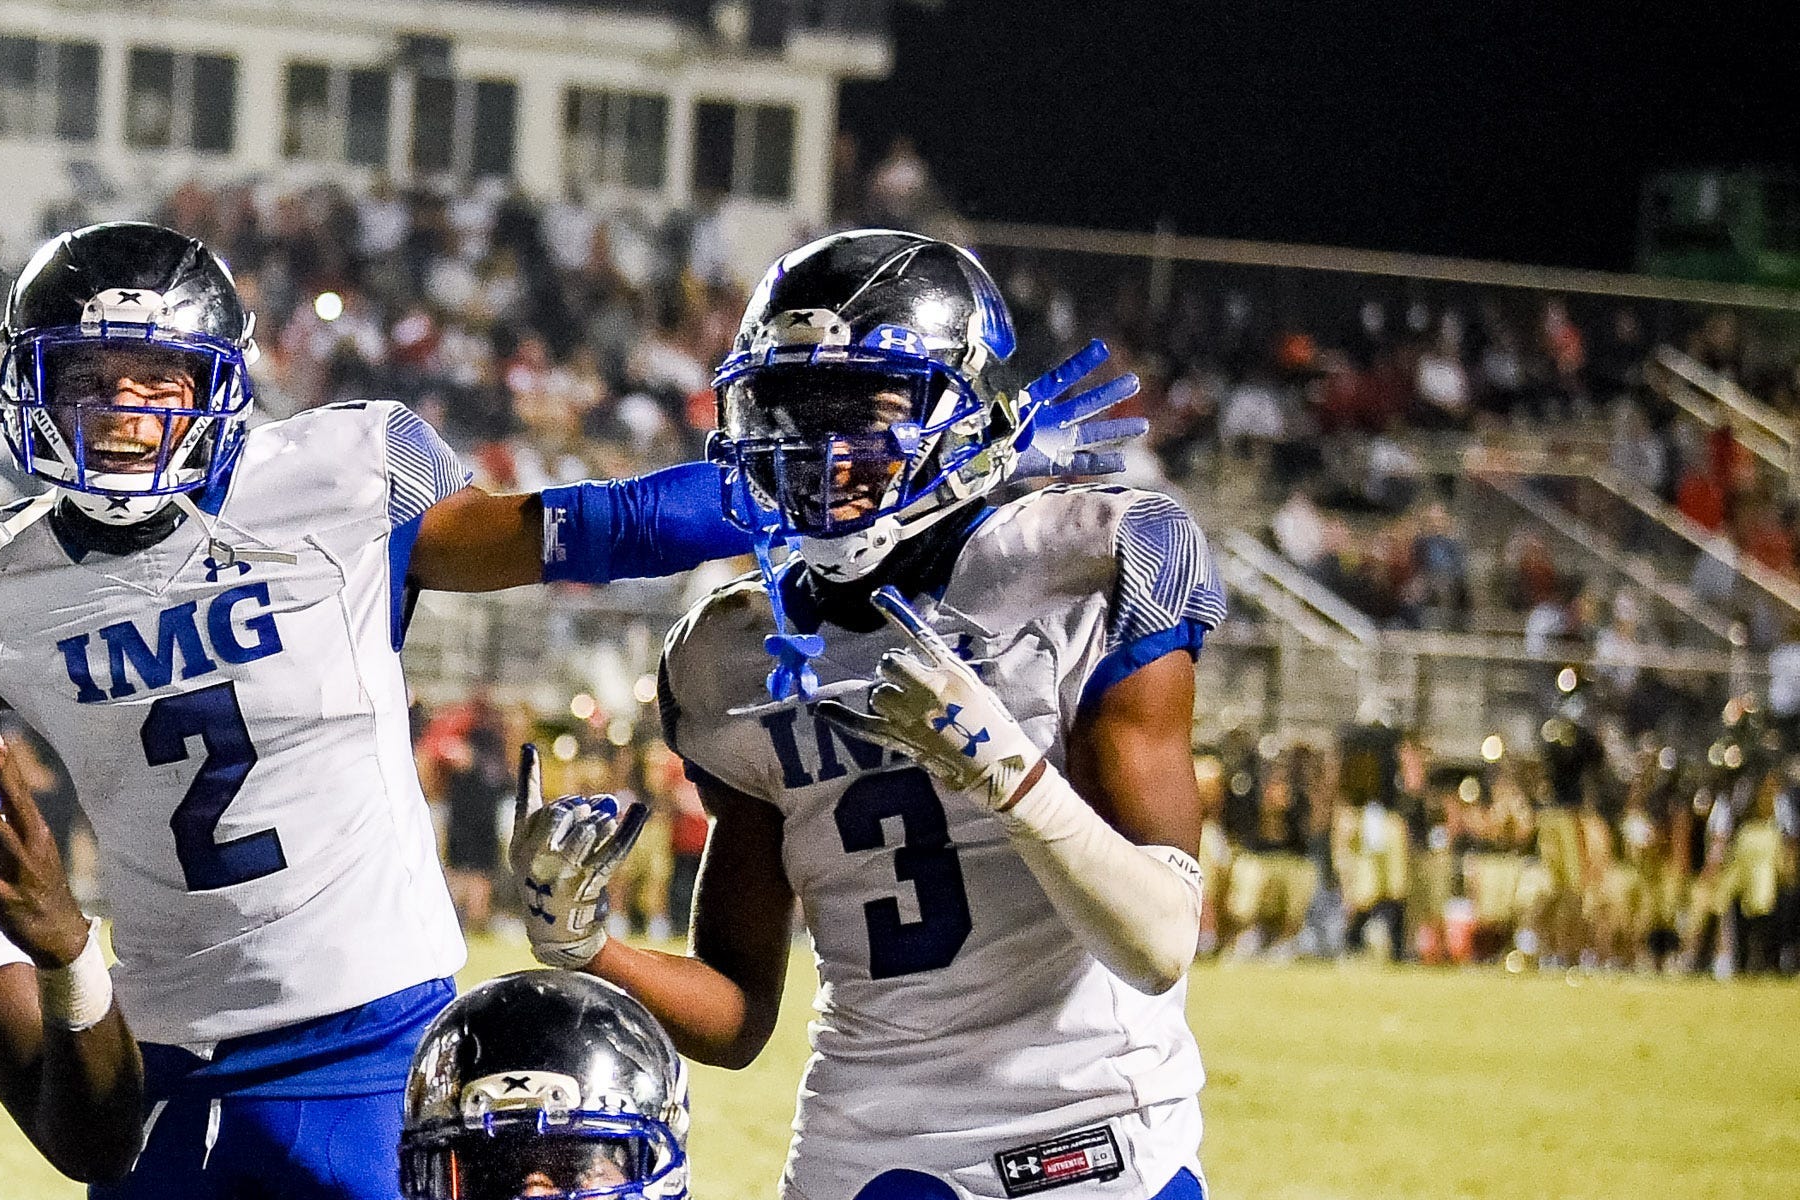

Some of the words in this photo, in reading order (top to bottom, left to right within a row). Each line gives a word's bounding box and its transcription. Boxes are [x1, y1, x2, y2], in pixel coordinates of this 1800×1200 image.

[57, 581, 285, 703] IMG
[139, 680, 288, 893] 2
[833, 767, 974, 981] 3
